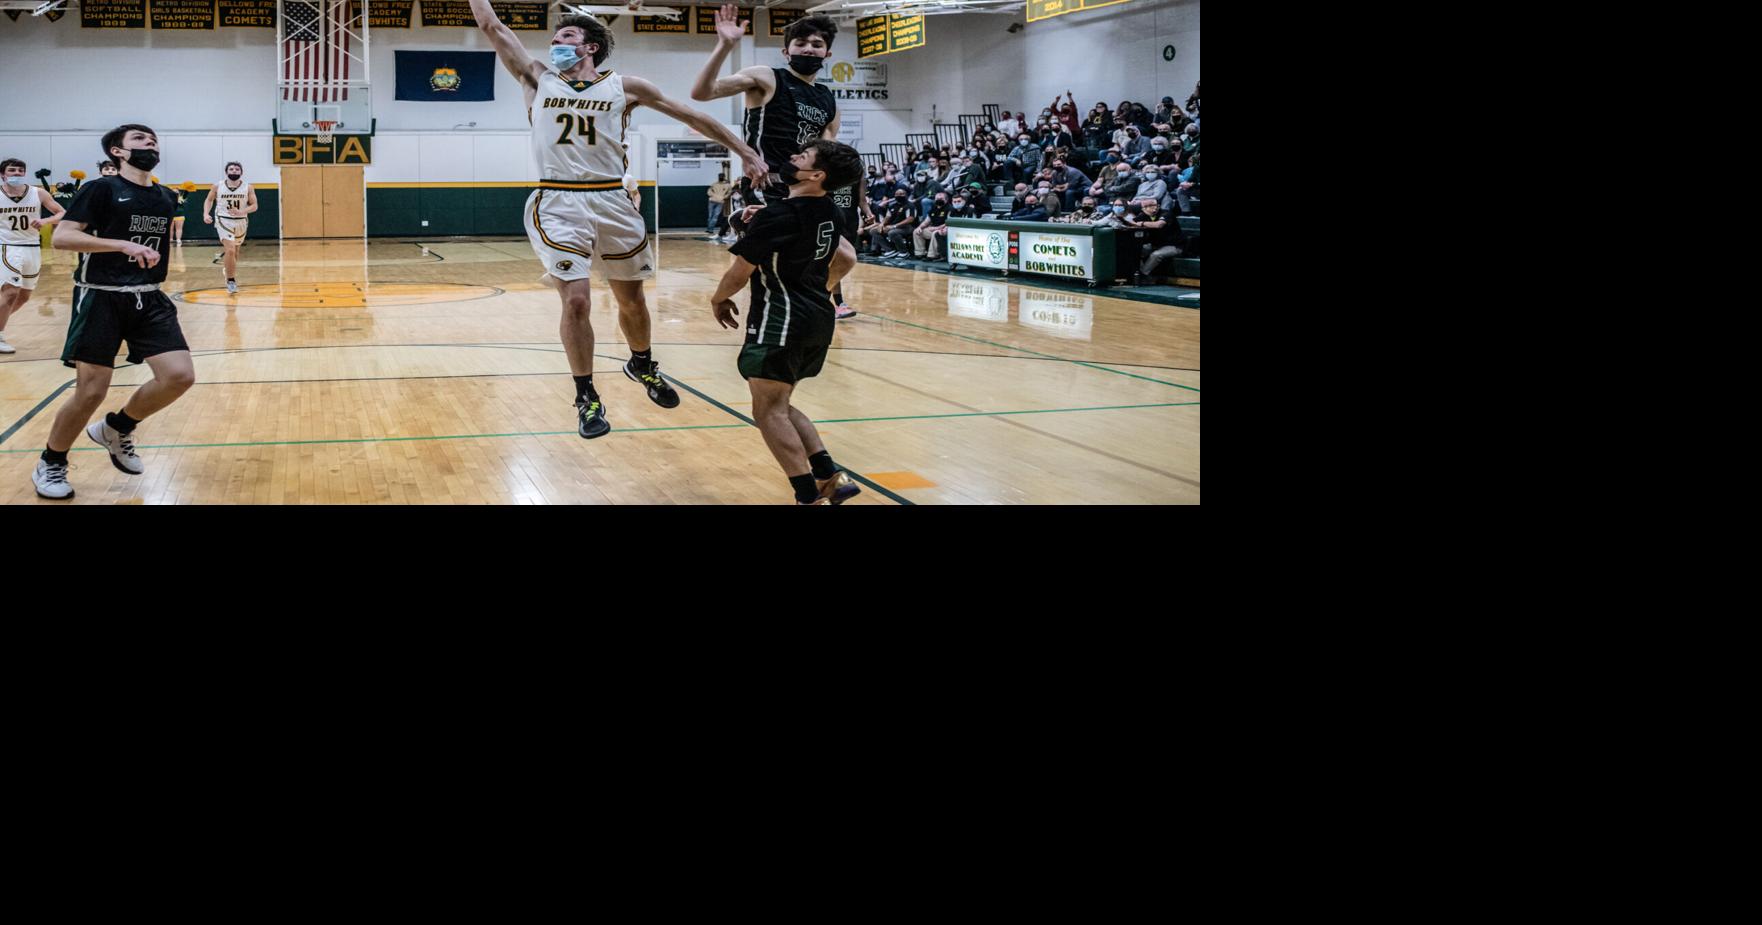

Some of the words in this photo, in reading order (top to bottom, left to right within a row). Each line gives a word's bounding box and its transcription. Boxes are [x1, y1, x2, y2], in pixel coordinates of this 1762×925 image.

[225, 16, 272, 25] COMETS
[357, 17, 408, 26] BBWHITES
[637, 23, 655, 31] STATE
[832, 89, 889, 100] LETICS
[543, 97, 613, 112] BOBWHITES
[556, 113, 597, 146] 24
[273, 136, 370, 163] BFA
[226, 199, 240, 210] 34
[833, 194, 852, 208] 23
[8, 214, 29, 231] 20
[129, 214, 168, 234] RICE
[814, 221, 835, 260] 5
[950, 242, 972, 252] BELLOWS
[972, 244, 985, 253] FREE
[951, 251, 984, 261] ACADEMY
[1033, 243, 1077, 257] COMETS
[1025, 260, 1086, 277] BOBWHITES
